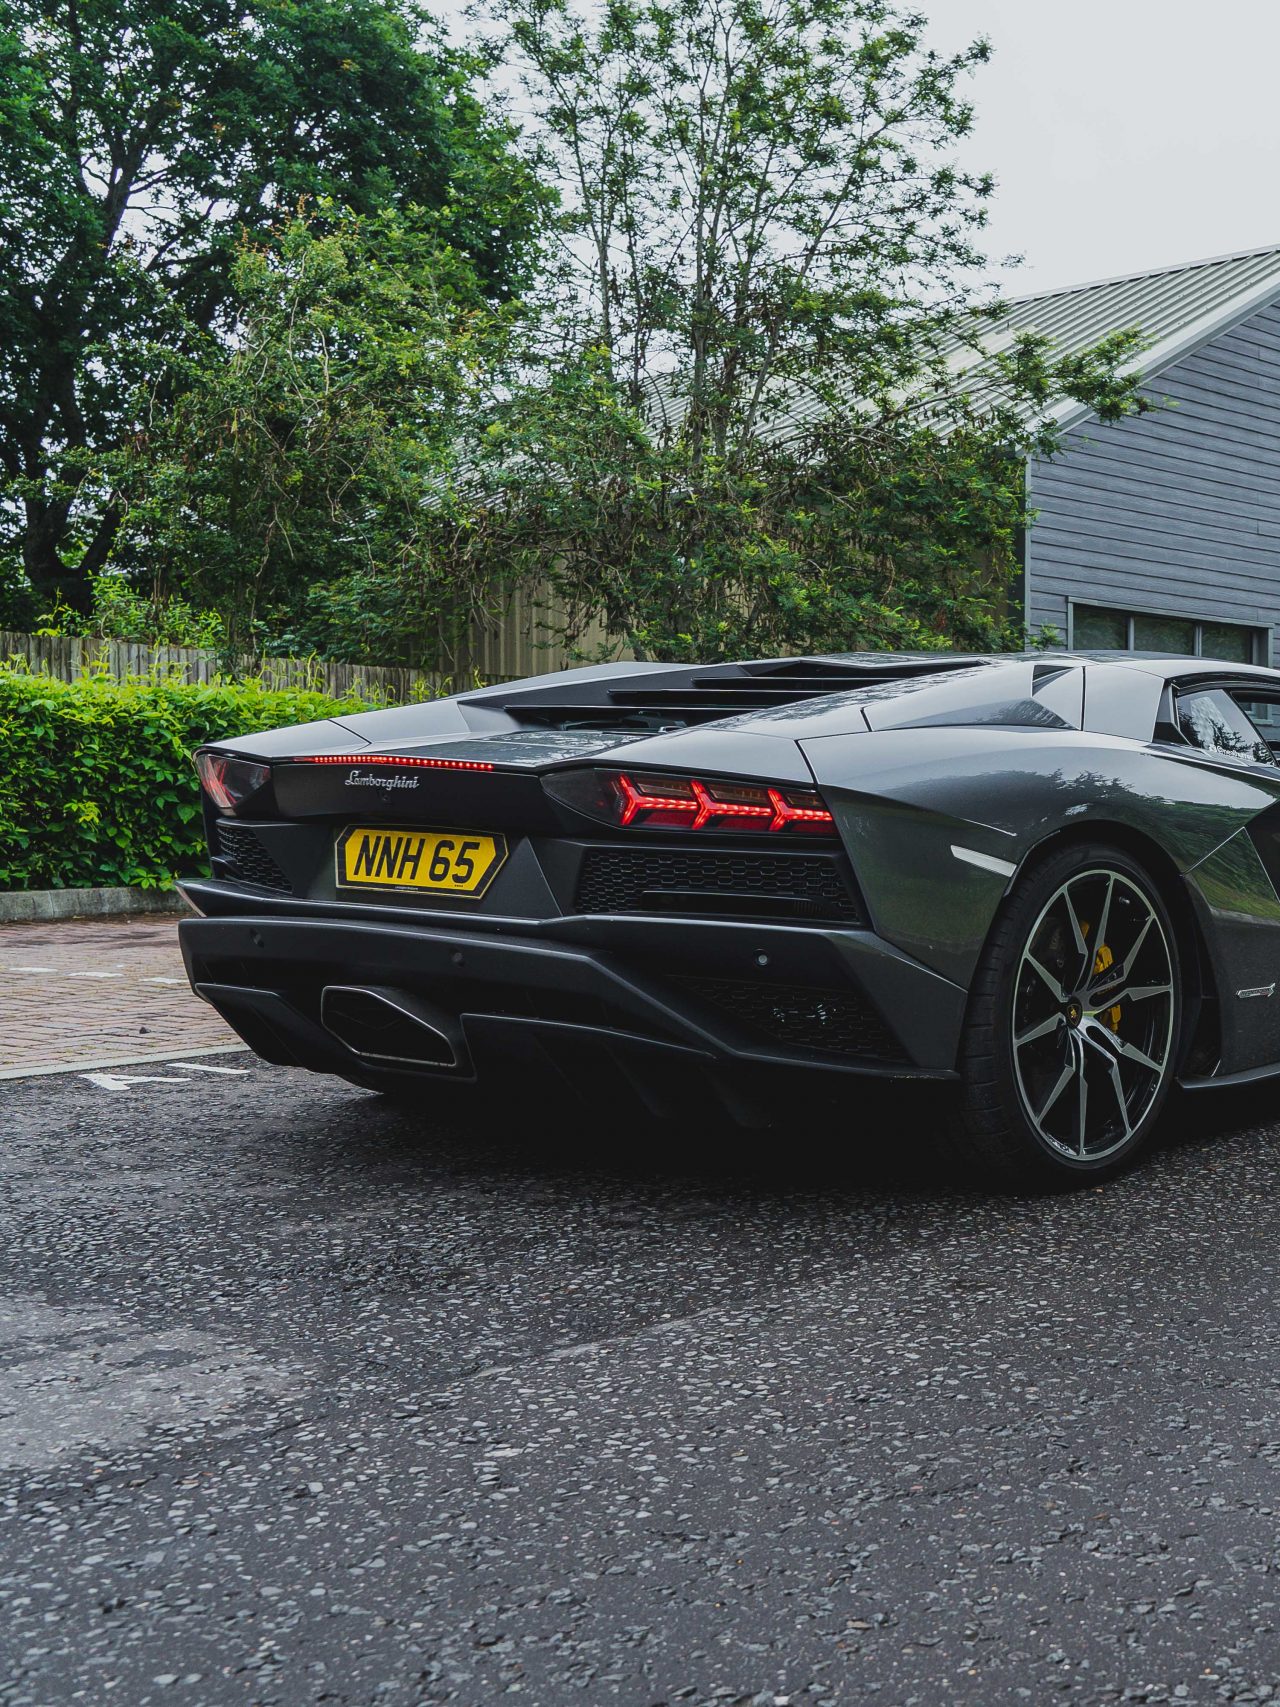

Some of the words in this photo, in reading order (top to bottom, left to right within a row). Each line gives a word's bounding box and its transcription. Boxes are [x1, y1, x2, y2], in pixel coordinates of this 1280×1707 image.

[345, 770, 420, 791] Lamborghini
[353, 834, 426, 880] NNH
[428, 840, 481, 884] 65
